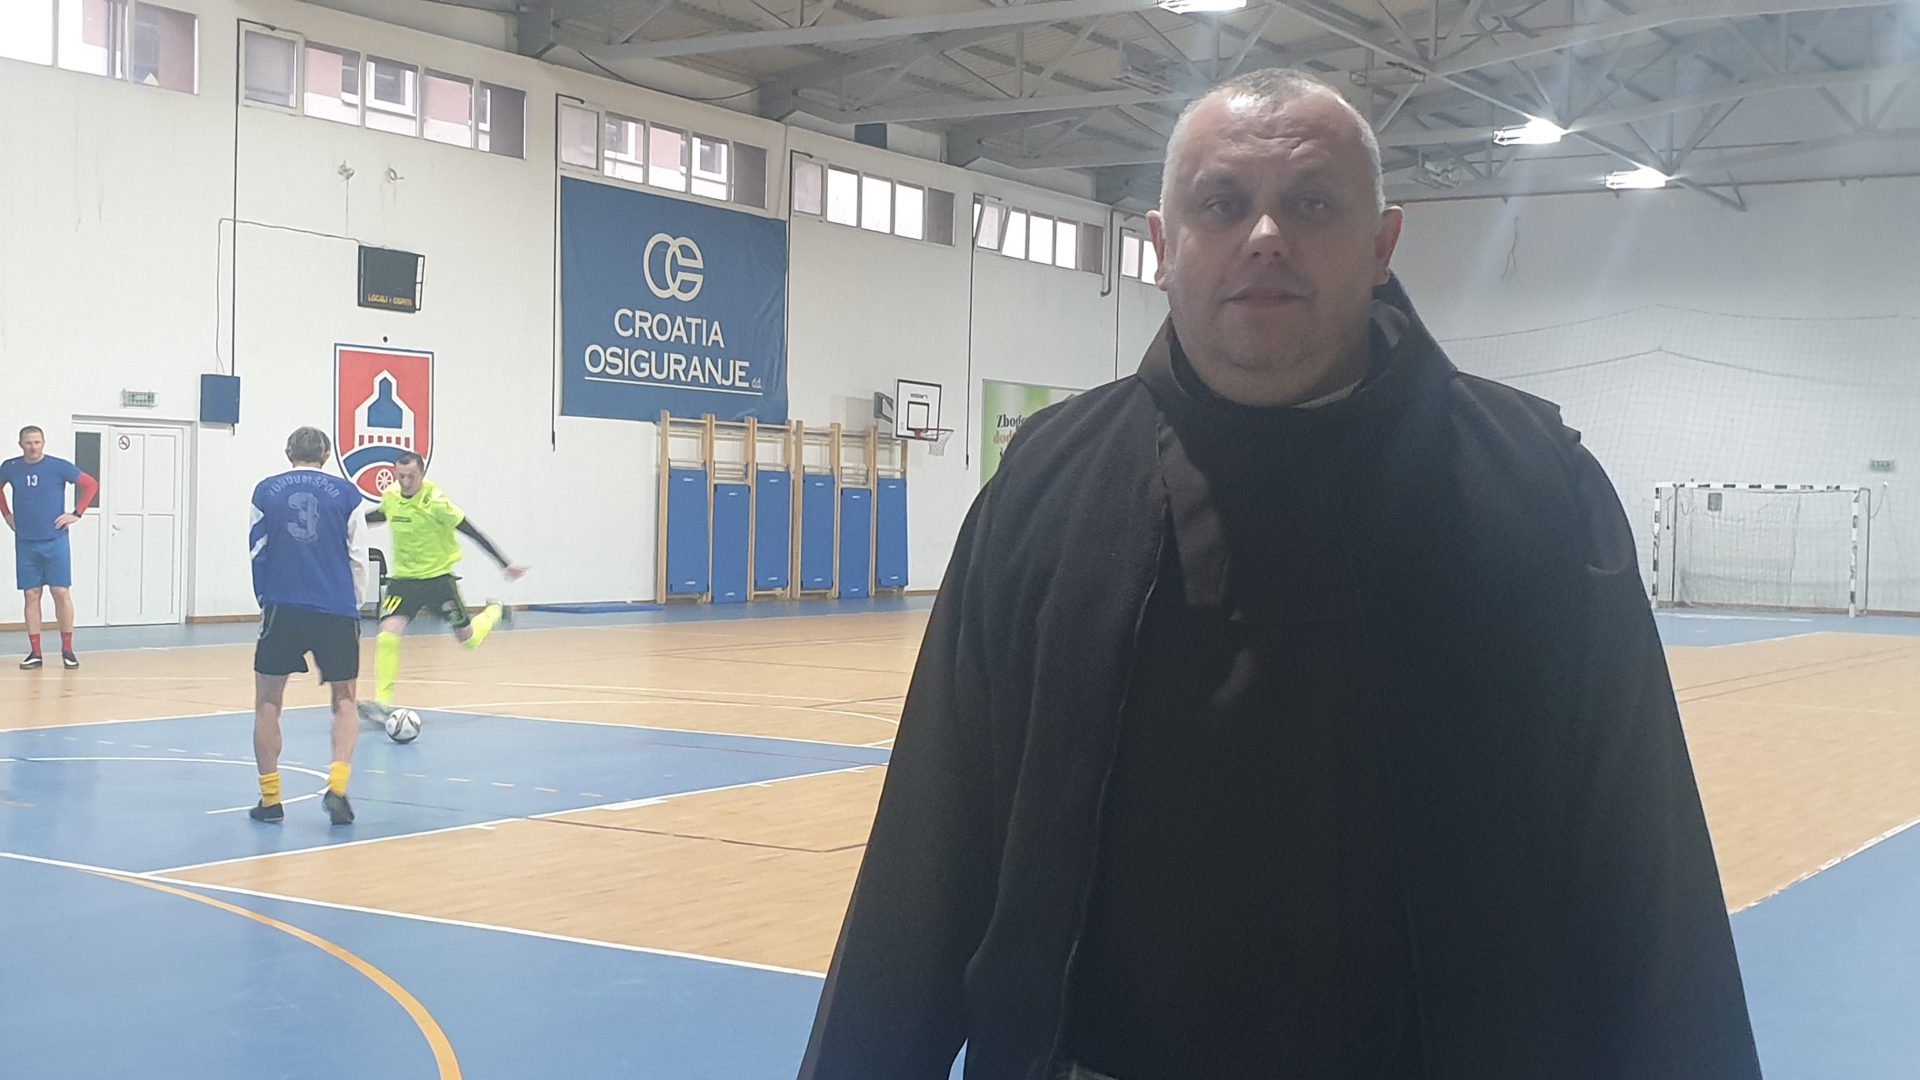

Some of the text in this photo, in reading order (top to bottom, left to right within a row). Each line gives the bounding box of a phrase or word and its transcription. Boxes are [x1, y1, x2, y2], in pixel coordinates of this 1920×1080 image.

[614, 308, 725, 349] CROATIA
[584, 344, 750, 388] OSIGURANJE
[26, 474, 38, 487] 13
[286, 491, 320, 543] 3
